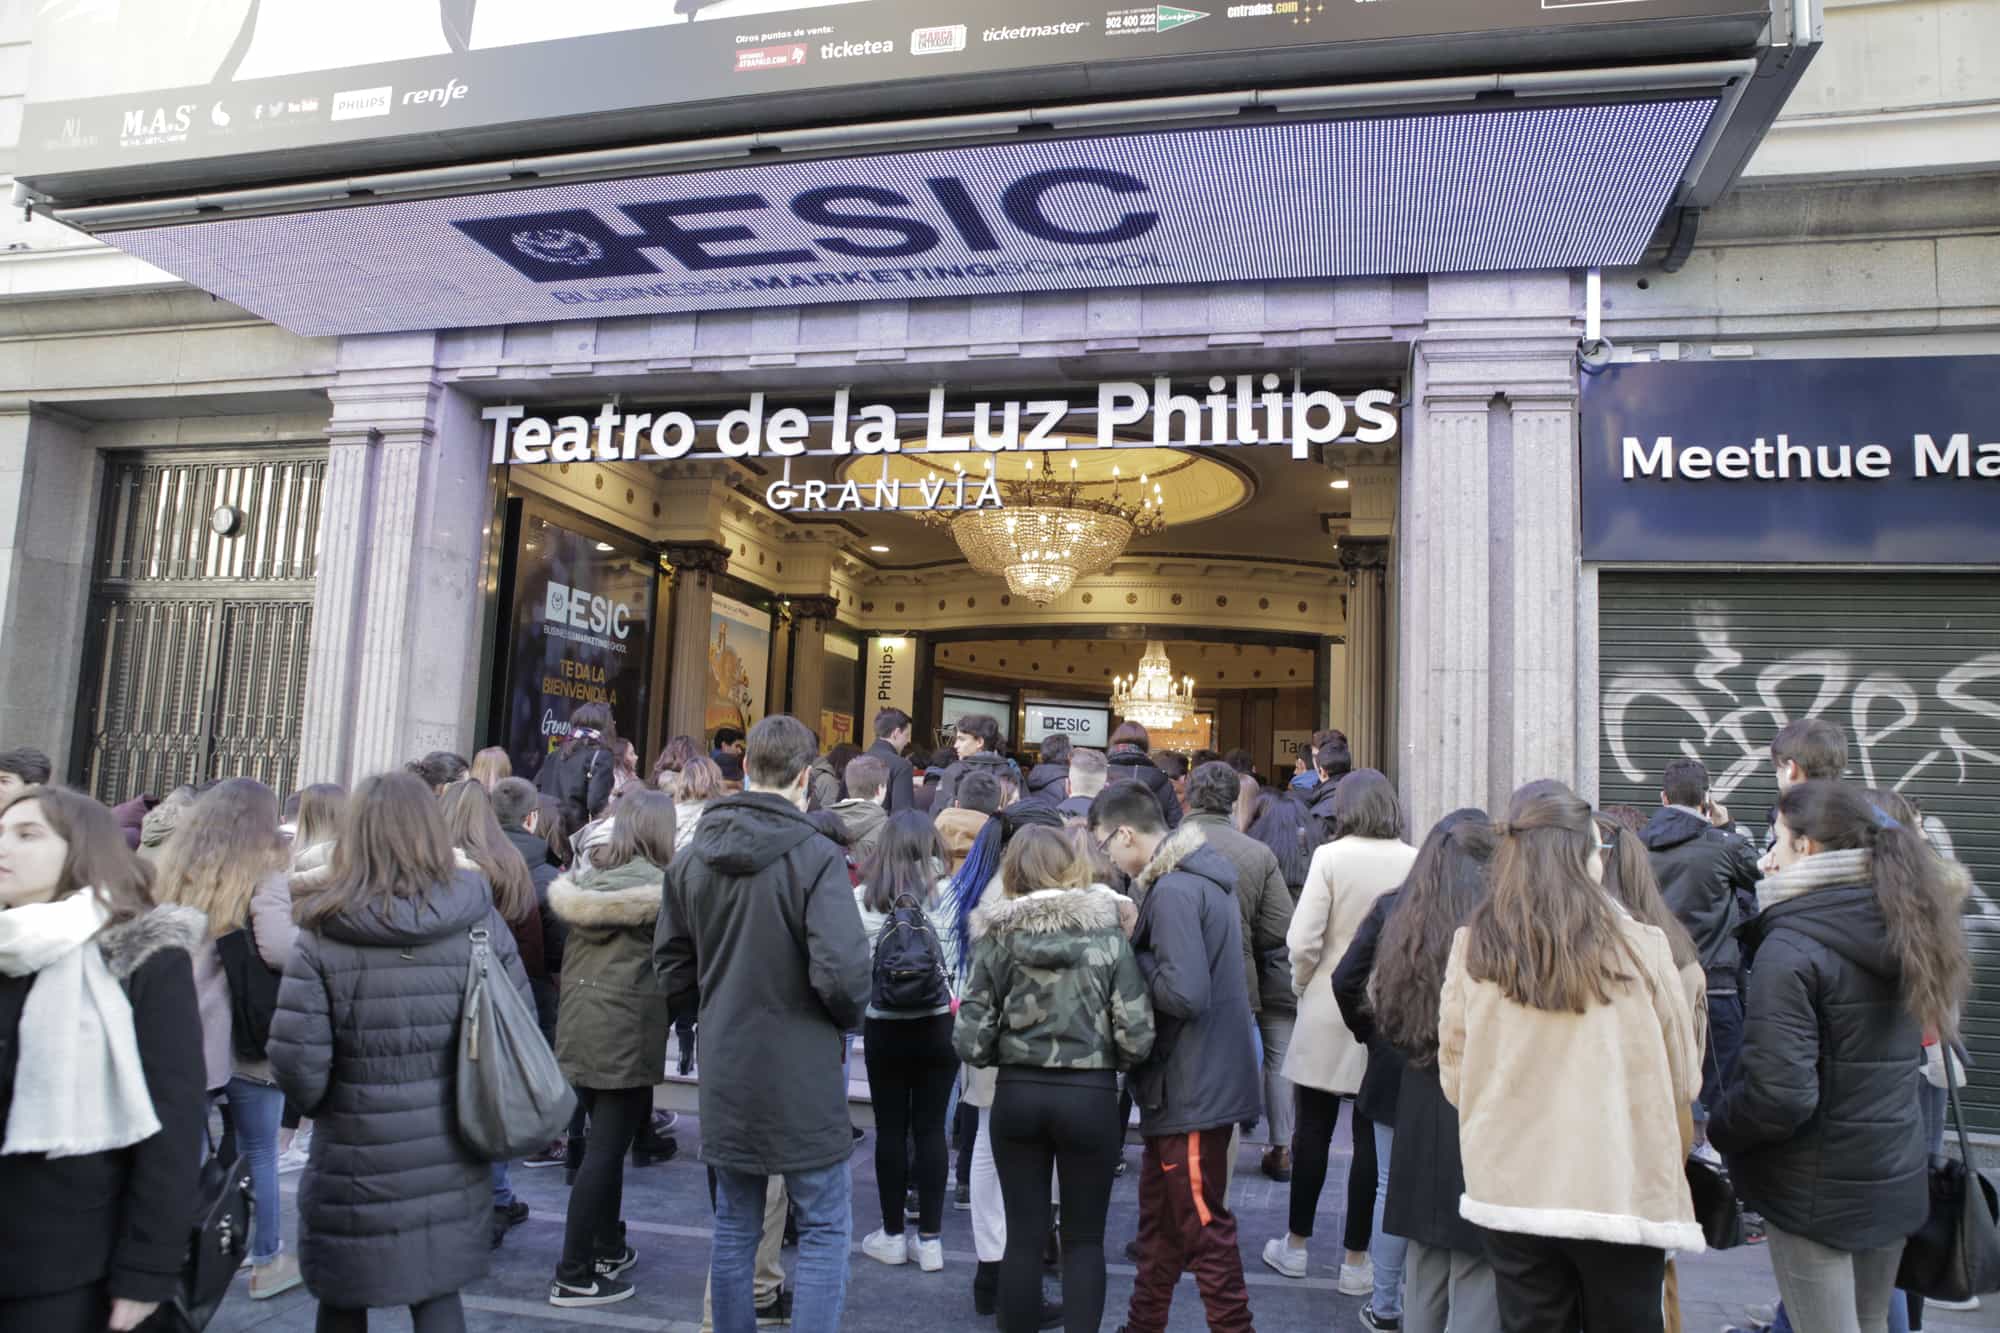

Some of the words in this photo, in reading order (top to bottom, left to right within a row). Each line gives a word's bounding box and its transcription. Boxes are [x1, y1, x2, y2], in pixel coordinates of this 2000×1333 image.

[1106, 17, 1122, 29] 902
[1123, 16, 1139, 28] 400
[1140, 14, 1156, 26] 222
[1227, 2, 1298, 18] entradas.com
[983, 21, 1084, 42] ticketmaster
[820, 40, 894, 60] ticketea
[338, 95, 386, 111] PHILIPS
[402, 78, 469, 108] renfe
[618, 167, 1160, 269] ESIC
[482, 402, 697, 464] Teatro
[716, 392, 809, 457] de
[831, 389, 901, 454] la
[926, 387, 1068, 451] Luz
[1098, 373, 1398, 459] Philips
[1622, 434, 1893, 479] Meethue
[766, 479, 900, 510] GRAN
[569, 588, 631, 640] ESIC
[560, 659, 574, 678] TE
[575, 662, 590, 681] DA
[592, 665, 605, 684] LA
[877, 645, 894, 701] Philips
[543, 678, 607, 704] BIENVENIDA
[1055, 716, 1091, 732] ESIC
